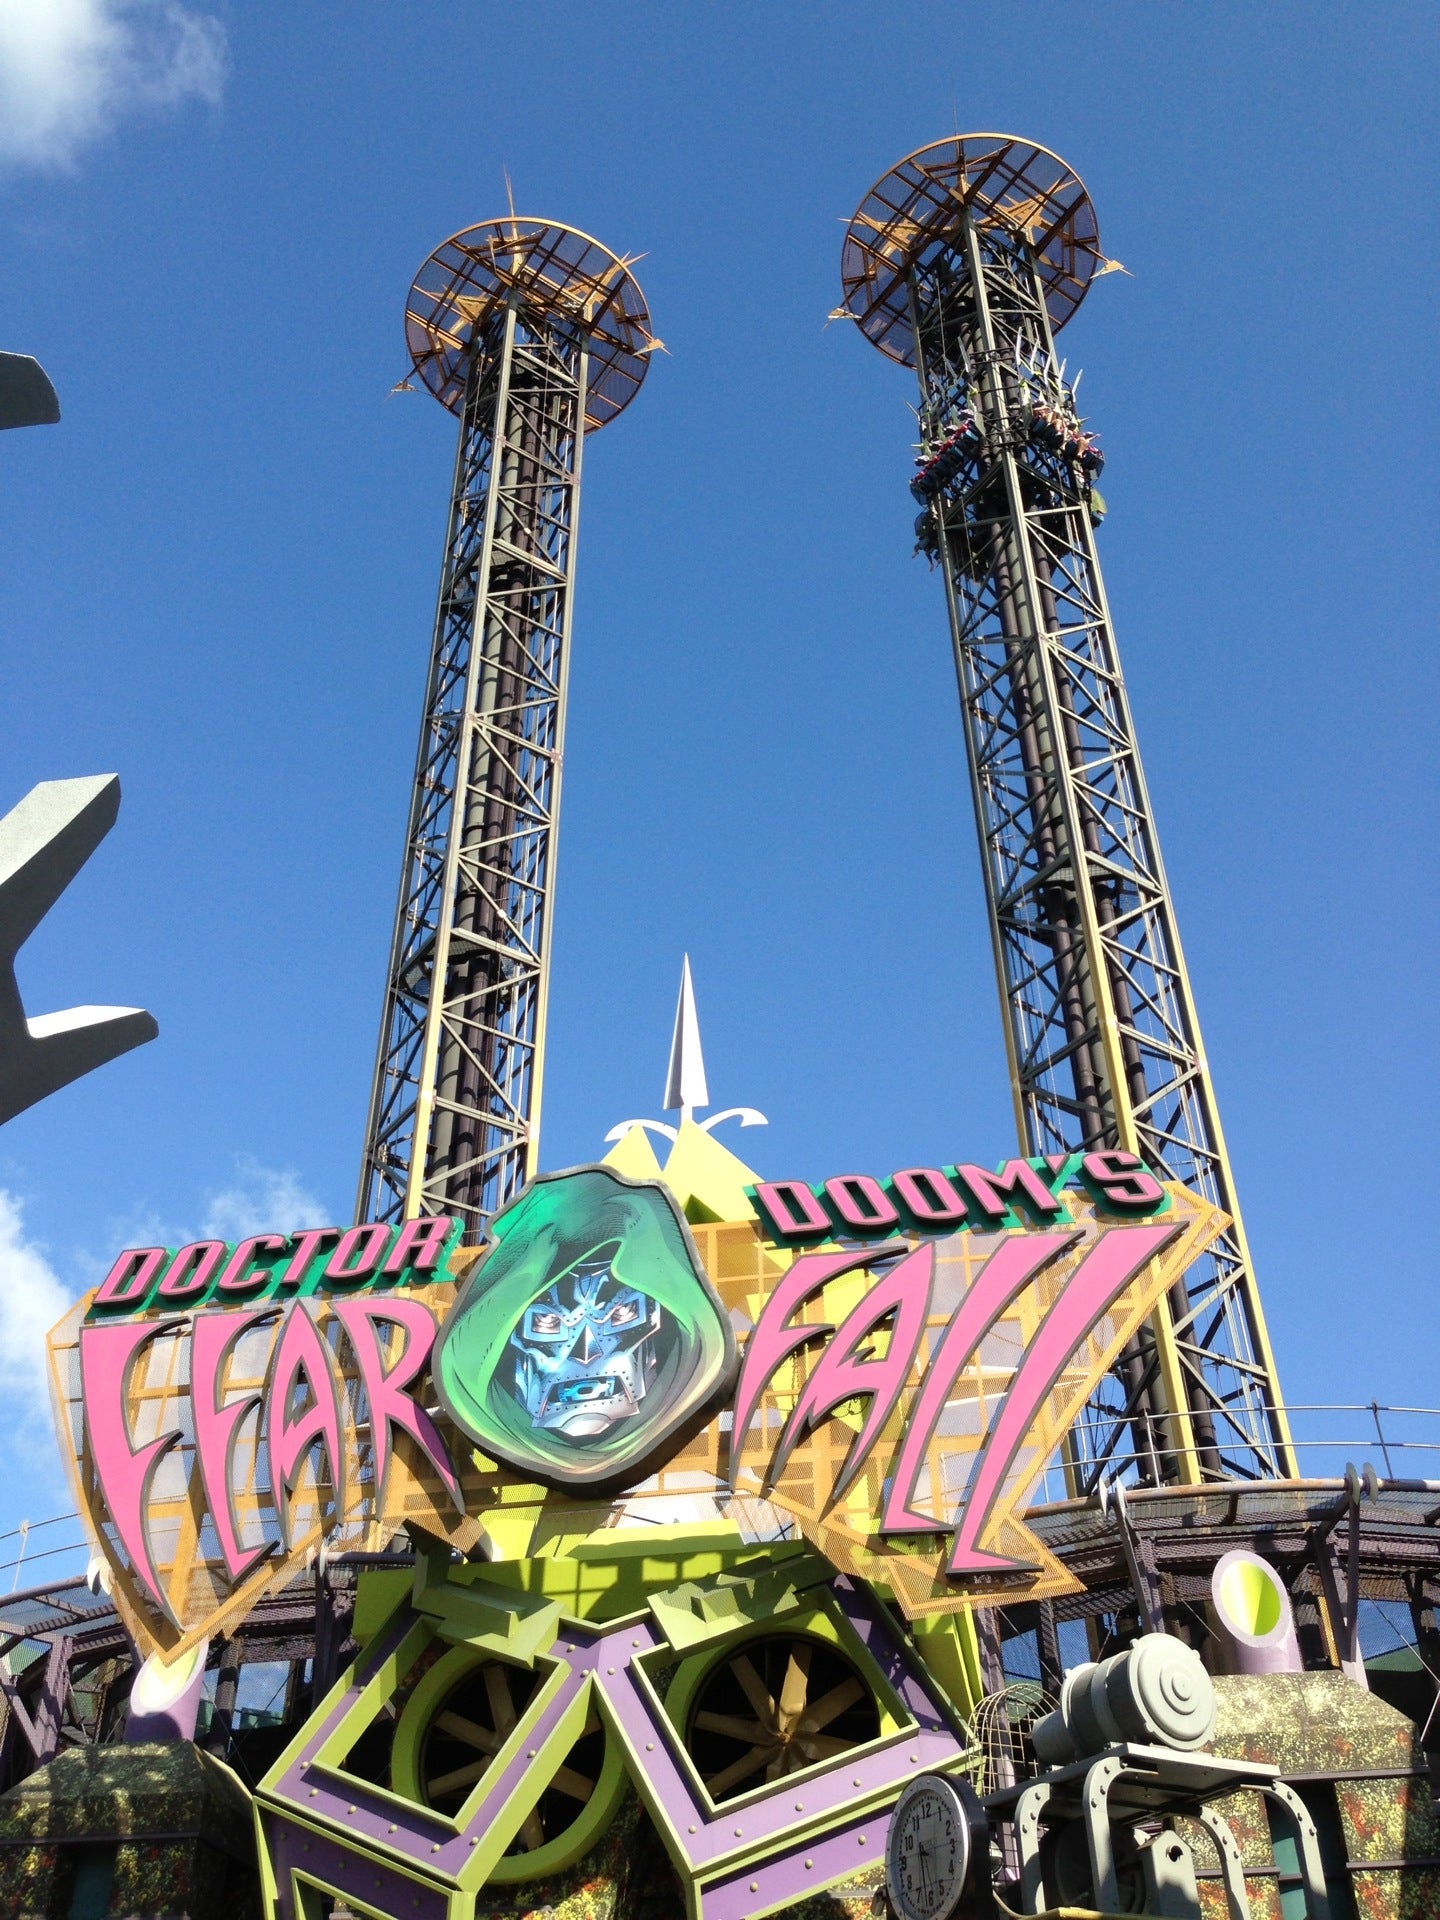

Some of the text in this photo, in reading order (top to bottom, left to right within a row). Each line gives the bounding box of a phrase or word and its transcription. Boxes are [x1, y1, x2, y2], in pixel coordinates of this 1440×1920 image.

[93, 1149, 1165, 1306] DOCTOR DOOM'S
[79, 1221, 1191, 1632] FEAR FALL
